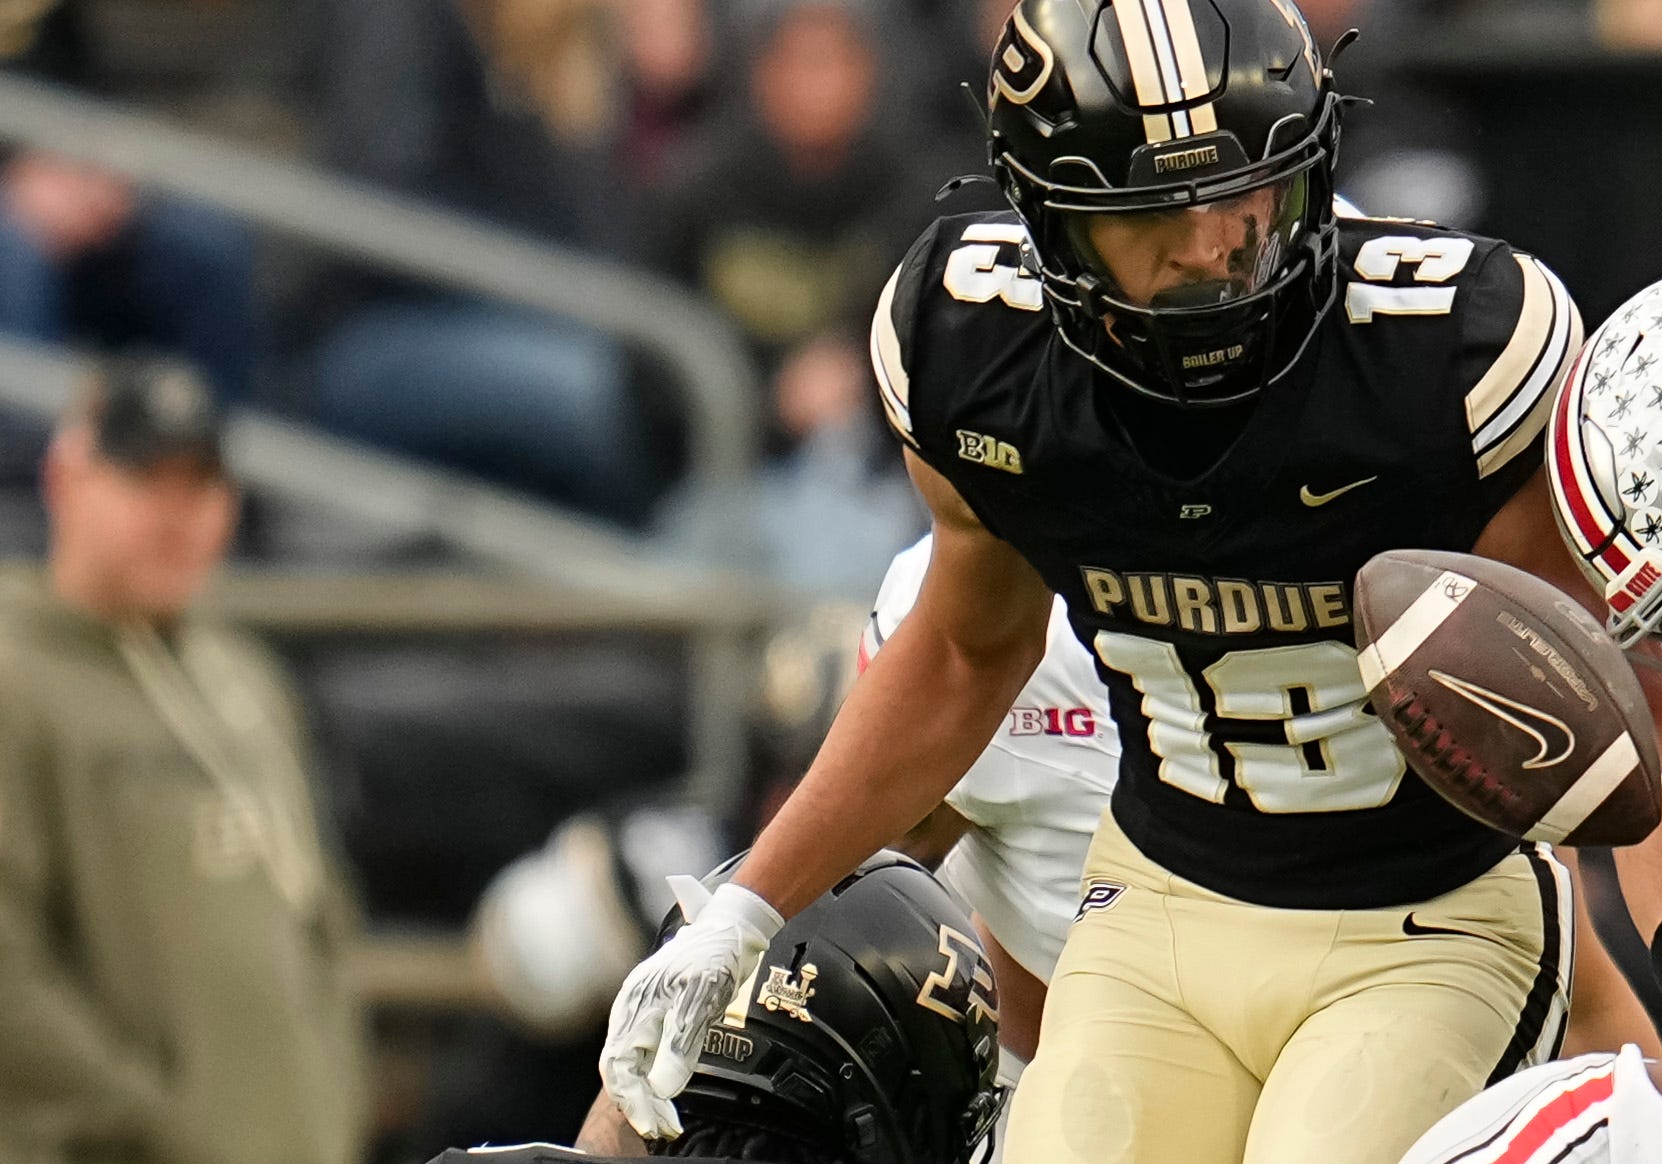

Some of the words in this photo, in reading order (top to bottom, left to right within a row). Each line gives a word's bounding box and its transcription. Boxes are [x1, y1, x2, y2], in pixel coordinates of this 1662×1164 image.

[1153, 144, 1220, 175] PURDUE
[1344, 235, 1476, 325] 13
[1182, 349, 1226, 370] BOILER
[1226, 343, 1244, 361] UP
[1079, 564, 1351, 636] PURDUE
[1093, 627, 1408, 815] 13
